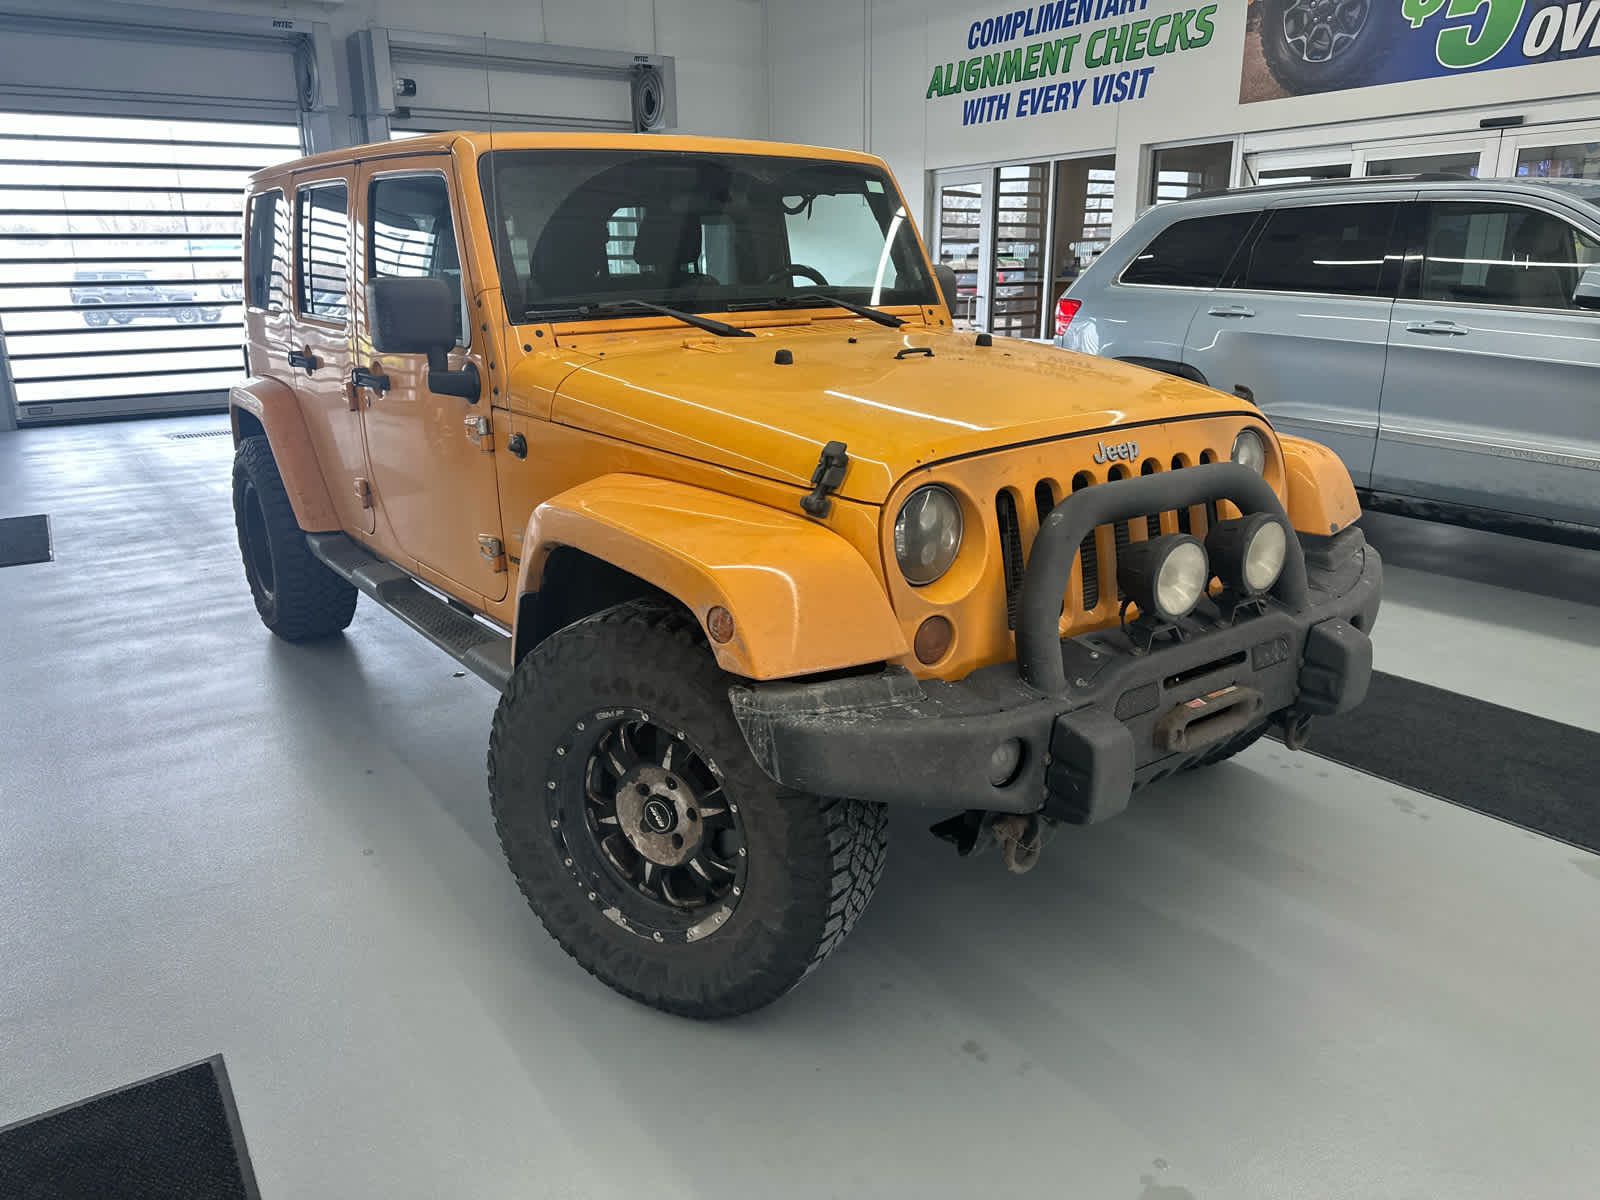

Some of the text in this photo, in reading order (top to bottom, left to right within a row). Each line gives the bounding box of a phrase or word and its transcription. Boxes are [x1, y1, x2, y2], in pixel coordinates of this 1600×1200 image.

[926, 4, 1218, 99] ALIGNMENT CHECKS
[962, 67, 1155, 126] WITH EVERY VISIT
[1093, 441, 1139, 464] Jeep
